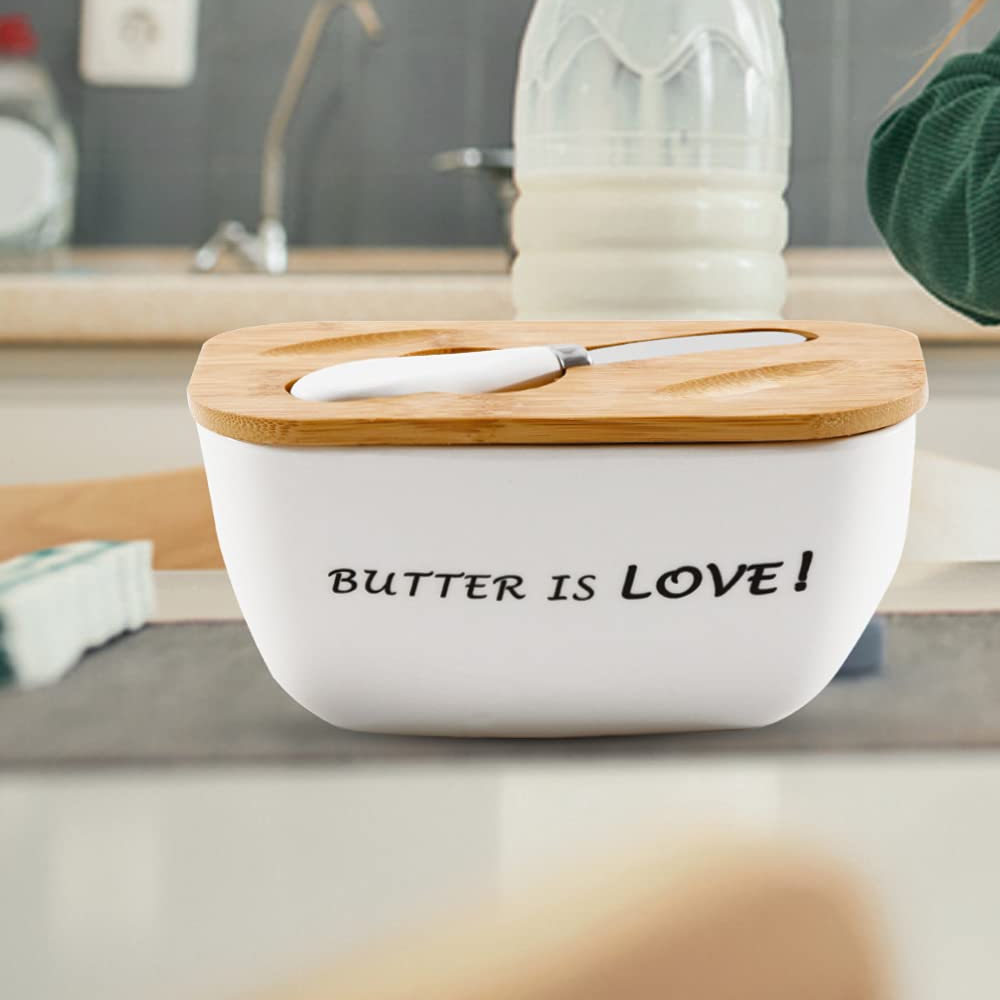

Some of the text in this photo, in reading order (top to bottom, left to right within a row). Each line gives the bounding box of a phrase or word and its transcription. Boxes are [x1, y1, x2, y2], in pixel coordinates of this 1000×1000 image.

[328, 550, 814, 601] BUTTER IS LOVE!
